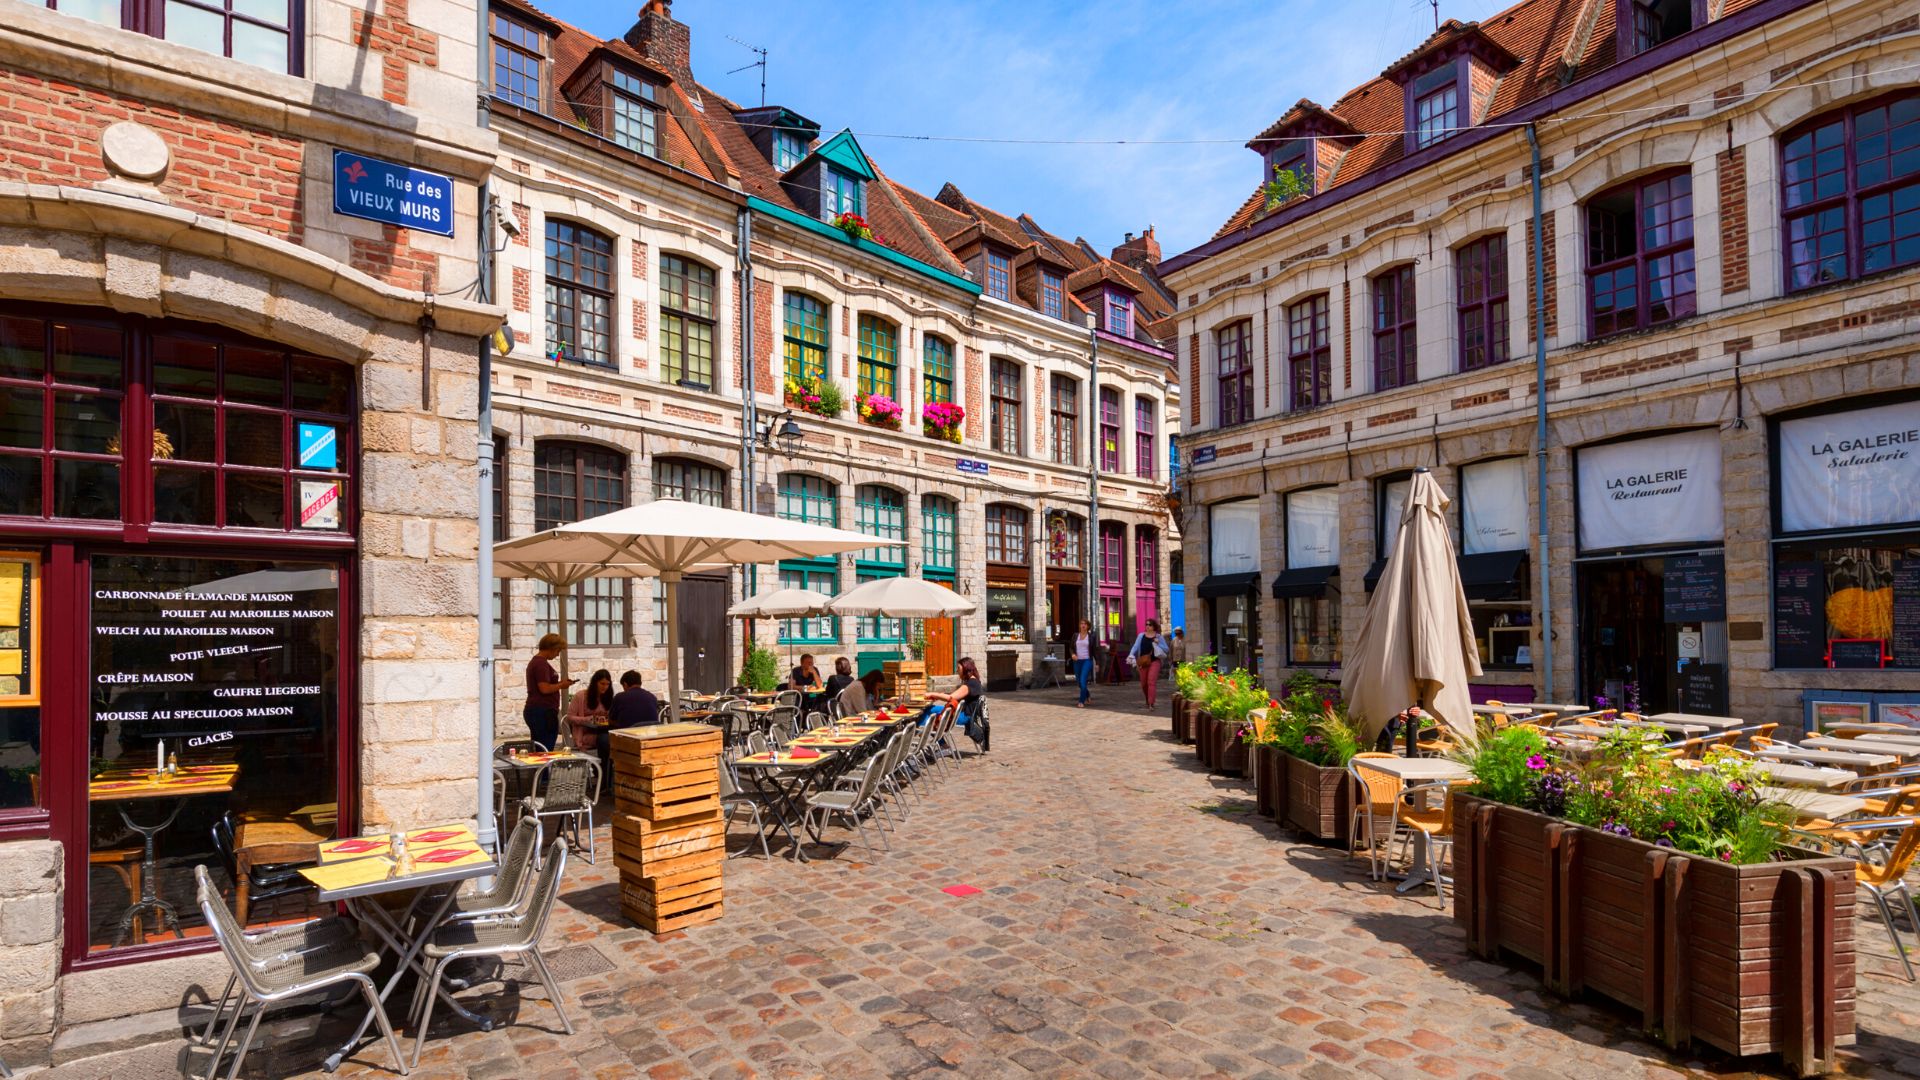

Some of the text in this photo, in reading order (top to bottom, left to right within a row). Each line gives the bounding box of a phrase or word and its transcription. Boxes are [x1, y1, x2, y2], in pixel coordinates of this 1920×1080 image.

[386, 173, 442, 199] Rue des
[349, 188, 441, 222] VIEUX MURS
[1812, 429, 1920, 456] LA GALERIE
[1827, 449, 1909, 468] Saladerie
[1606, 468, 1688, 490] LA GALERIE
[1611, 484, 1682, 500] Restaurant
[303, 488, 335, 521] LICENCE
[95, 590, 294, 602] CARBONNADE FLAMANDE MAISON
[161, 609, 334, 618] POULET AU MAROILLES MAISON
[96, 626, 274, 636] WELCH AU MAROILLES MAISON
[169, 644, 249, 662] POTJE VLEECH
[97, 672, 194, 683] CRÊPE MAISON
[213, 685, 321, 697] GAUFRE LIEGEOISE
[95, 706, 294, 721] MOUSSE AU SPECULOOS MAISON
[188, 730, 234, 747] GLACES
